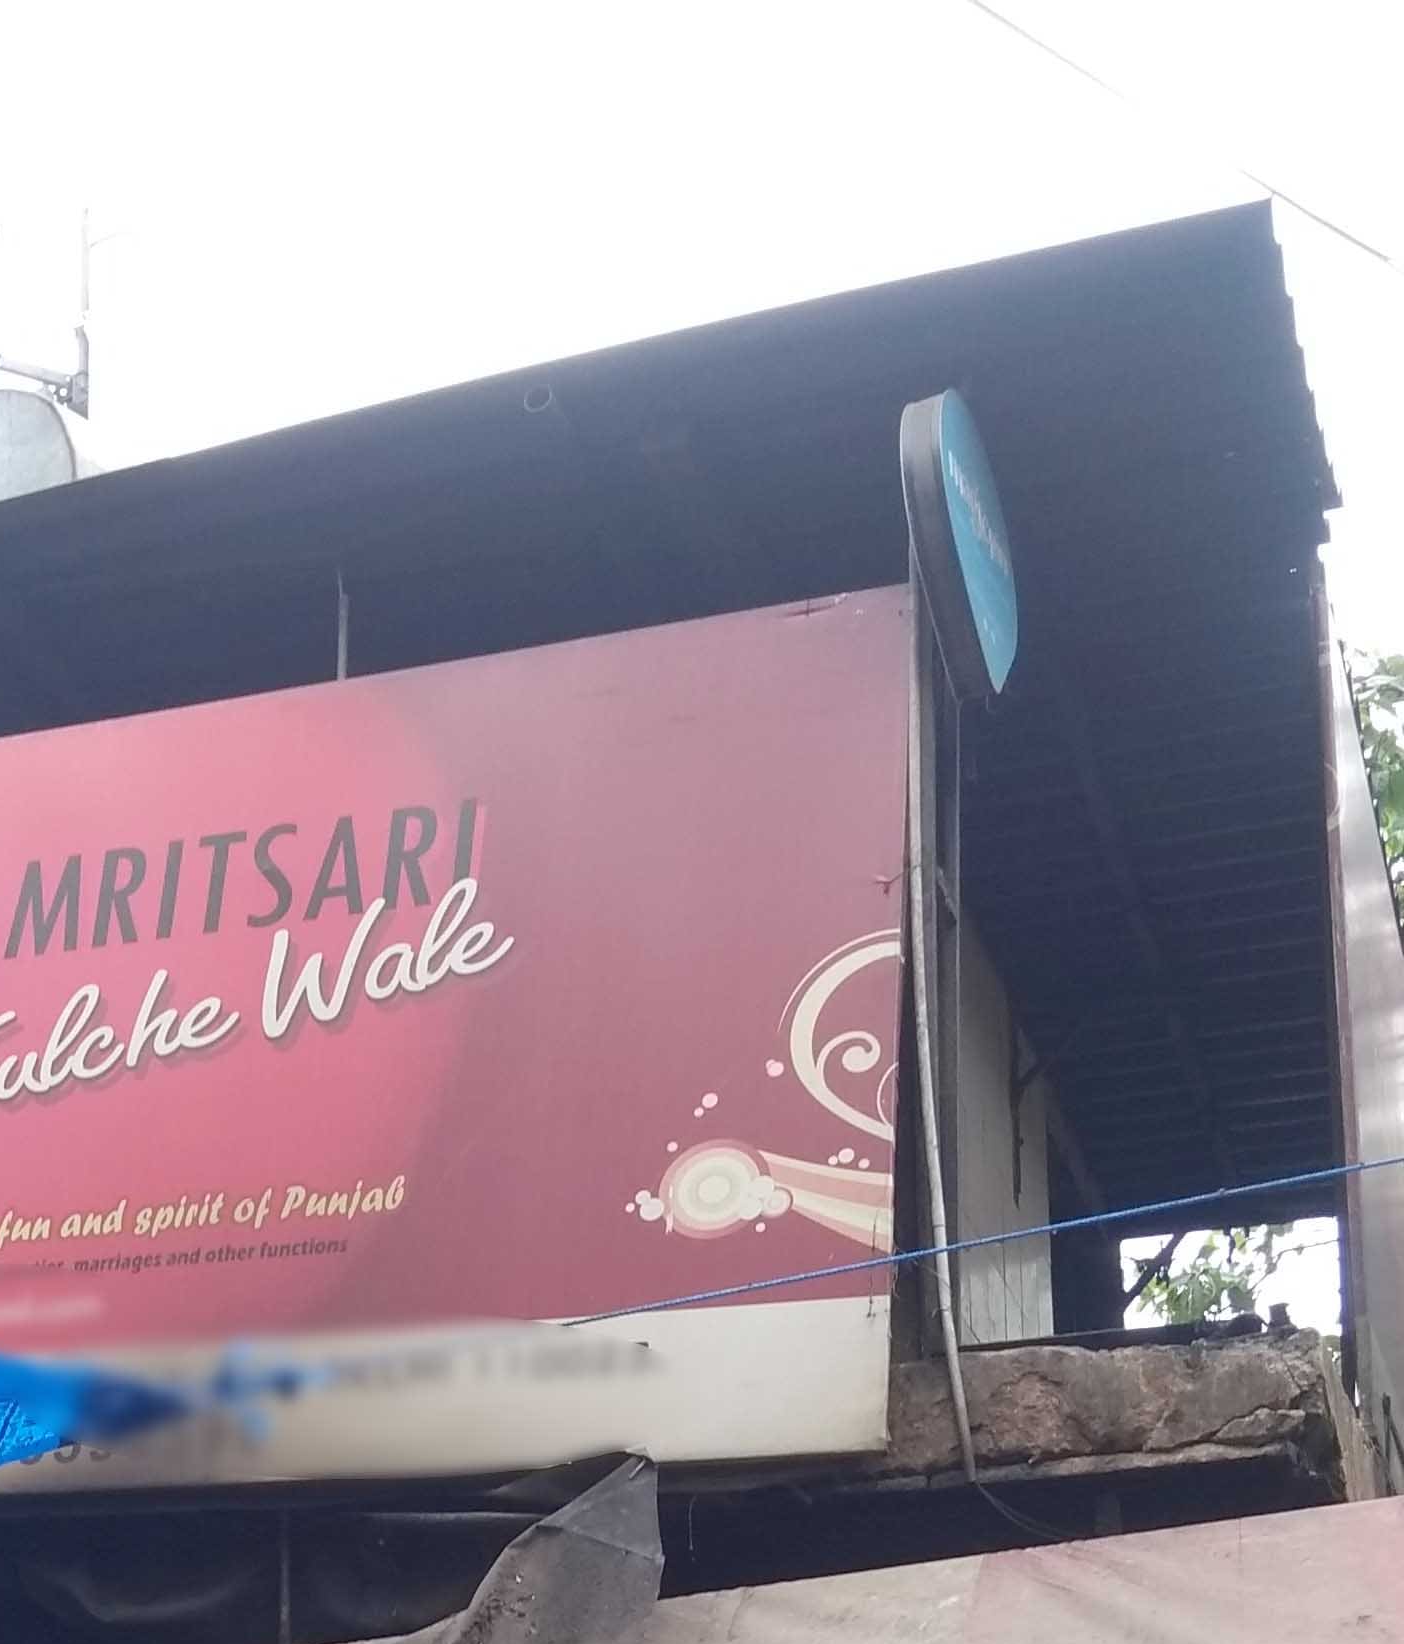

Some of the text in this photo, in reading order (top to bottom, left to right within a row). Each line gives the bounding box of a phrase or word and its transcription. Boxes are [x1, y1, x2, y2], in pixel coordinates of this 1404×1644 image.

[260, 876, 514, 1038] Wale
[60, 1200, 127, 1239] and
[134, 1193, 225, 1238] spirit
[233, 1188, 272, 1229] of
[280, 1175, 405, 1220] Punjab
[74, 1252, 162, 1275] marriages
[165, 1248, 201, 1267] and
[205, 1243, 254, 1263] other
[260, 1236, 348, 1260] functions
